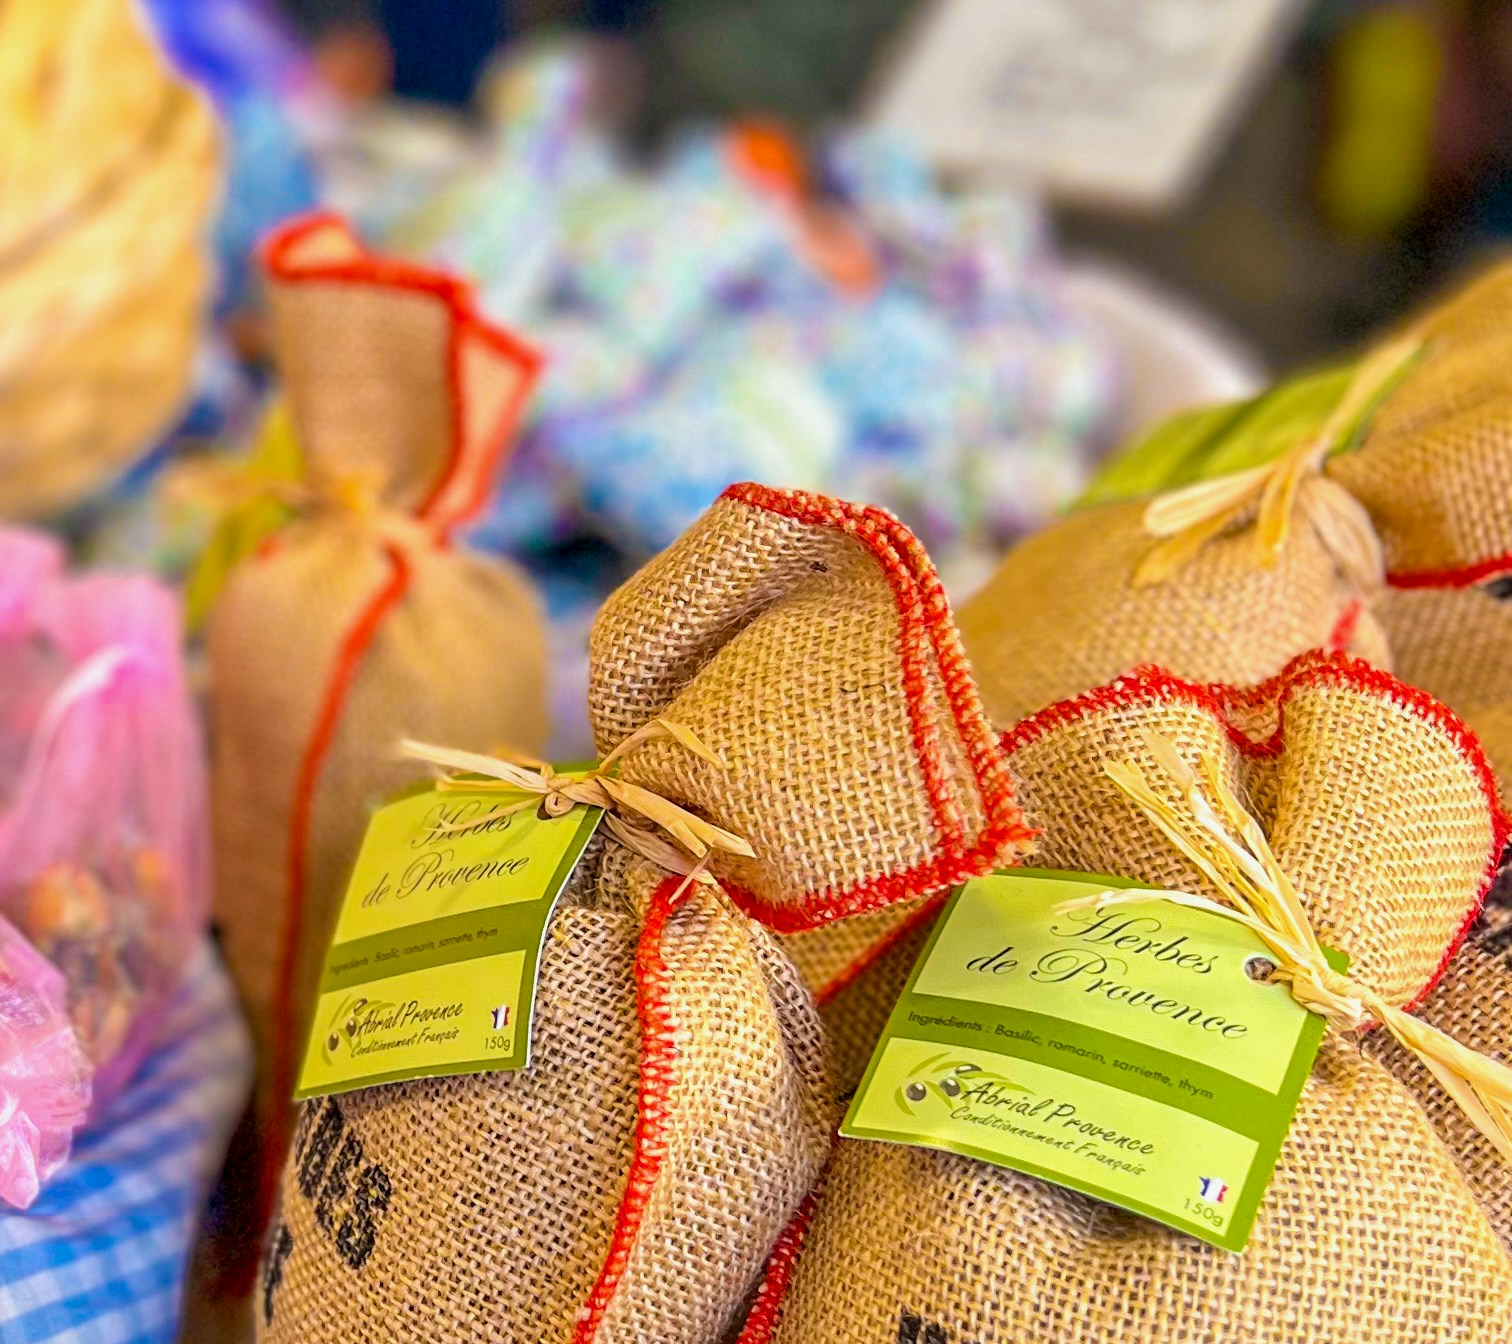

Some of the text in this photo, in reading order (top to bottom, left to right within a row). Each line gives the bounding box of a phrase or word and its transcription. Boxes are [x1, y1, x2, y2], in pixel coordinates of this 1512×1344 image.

[362, 848, 529, 908] de Provence
[1049, 905, 1219, 975] Herbes
[356, 1000, 464, 1036] Abrial Provence
[965, 946, 1248, 1040] de Provence
[484, 1035, 511, 1052] 150g
[959, 1080, 1156, 1155] Abrial Provence
[1178, 1078, 1214, 1100] thym
[949, 1105, 1147, 1175] Conditionnement Français
[1184, 1197, 1225, 1227] 150g
